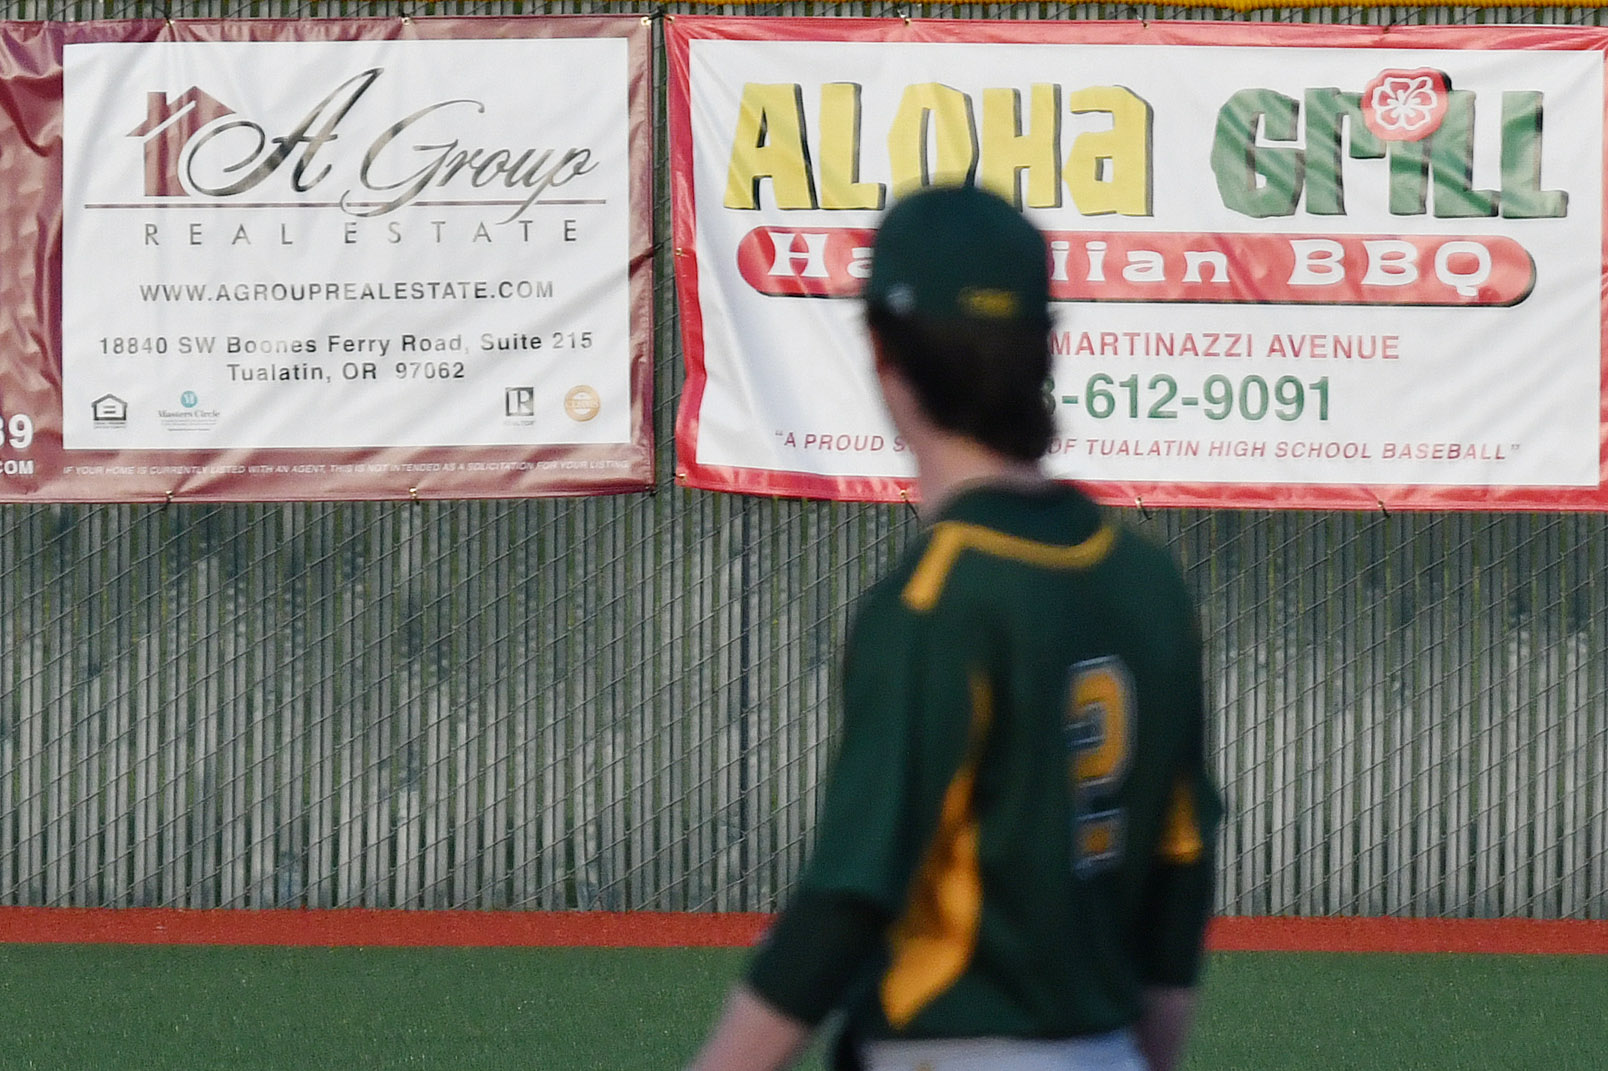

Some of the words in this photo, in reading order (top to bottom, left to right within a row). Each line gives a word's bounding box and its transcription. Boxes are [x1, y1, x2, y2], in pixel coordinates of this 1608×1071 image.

[185, 66, 384, 197] A
[339, 99, 600, 224] Group
[145, 222, 293, 246] REAL
[345, 219, 577, 244] ESTATE
[767, 233, 1231, 285] Haiian
[1286, 240, 1493, 297] BBQ
[140, 280, 555, 303] WWW.AGROUPREALESTATE.COM
[100, 336, 168, 356] 18840
[178, 336, 216, 355] SW
[227, 335, 318, 355] Boones
[328, 335, 391, 358] Ferry
[402, 333, 470, 355] Road,
[481, 333, 543, 353] Suite
[552, 331, 594, 351] 215
[1049, 331, 1253, 358] MARTINAZZI
[1267, 333, 1401, 360] AVENUE
[227, 363, 332, 383] Tualatin,
[342, 363, 378, 381] OR
[395, 361, 466, 380] 97062
[804, 433, 885, 452] PROUD
[1086, 439, 1200, 457] TUALATIN
[1208, 441, 1266, 459] HIGH
[1274, 442, 1372, 460] SCHOOL
[105, 466, 134, 475] HOME
[149, 465, 207, 475] CURRENTLY
[248, 465, 272, 474] WITH
[330, 464, 352, 474] THIS
[367, 464, 389, 473] NOT
[390, 463, 440, 473] INTENDED
[467, 462, 534, 472] SOLICITATION
[559, 461, 587, 471] YOUR
